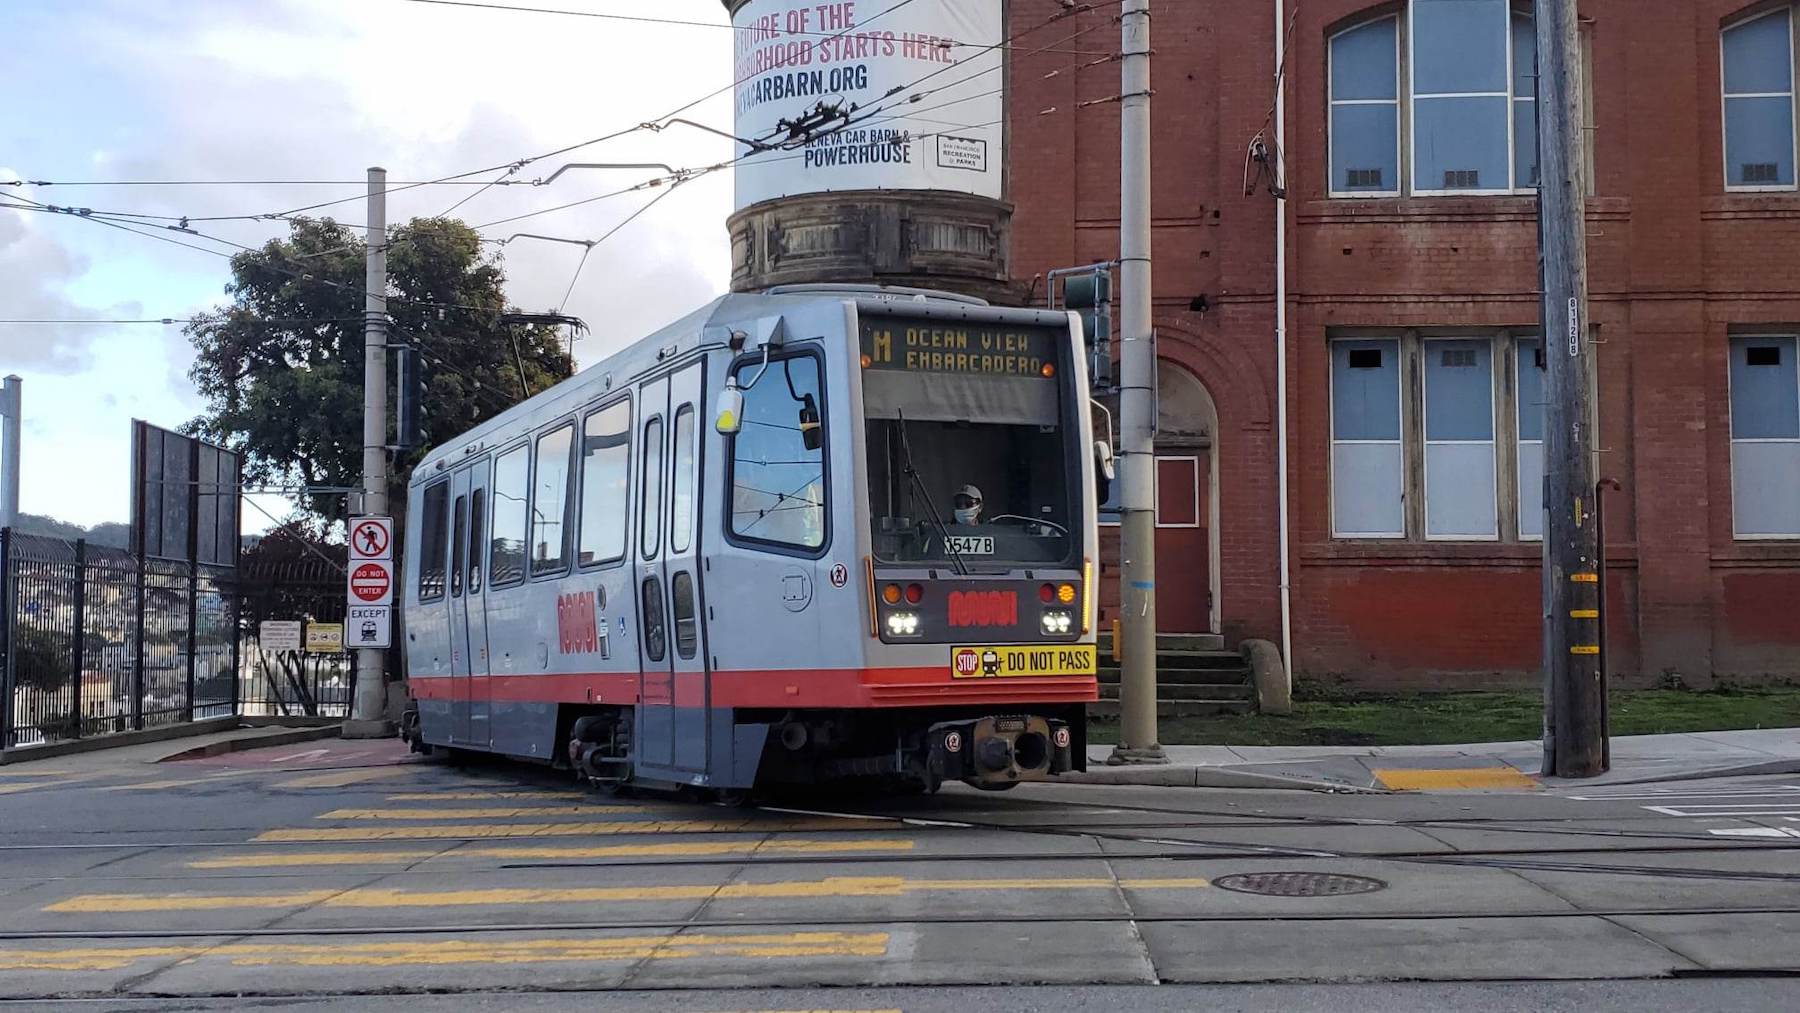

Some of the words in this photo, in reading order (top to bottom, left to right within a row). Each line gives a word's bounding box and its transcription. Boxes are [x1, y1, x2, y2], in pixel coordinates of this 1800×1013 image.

[786, 8, 810, 35] OF
[816, 2, 855, 32] THE
[819, 31, 895, 63] STARTS
[902, 33, 958, 64] HERE.
[845, 130, 866, 144] CAR
[870, 129, 899, 144] BARN
[903, 130, 911, 143] &
[805, 144, 911, 168] POWERHOUSE
[1569, 298, 1577, 354] 811208
[873, 330, 892, 362] M
[906, 328, 967, 349] OCEAN
[981, 332, 1028, 351] VIEW
[906, 351, 1041, 374] EMBARCADERO
[356, 570, 367, 578] DO
[370, 570, 384, 578] NOT
[358, 587, 382, 595] ENTER
[351, 609, 387, 618] EXCEPT
[957, 655, 978, 672] STOP
[1008, 652, 1025, 671] DO
[1030, 652, 1055, 670] NOT
[1059, 651, 1090, 670] PASS
